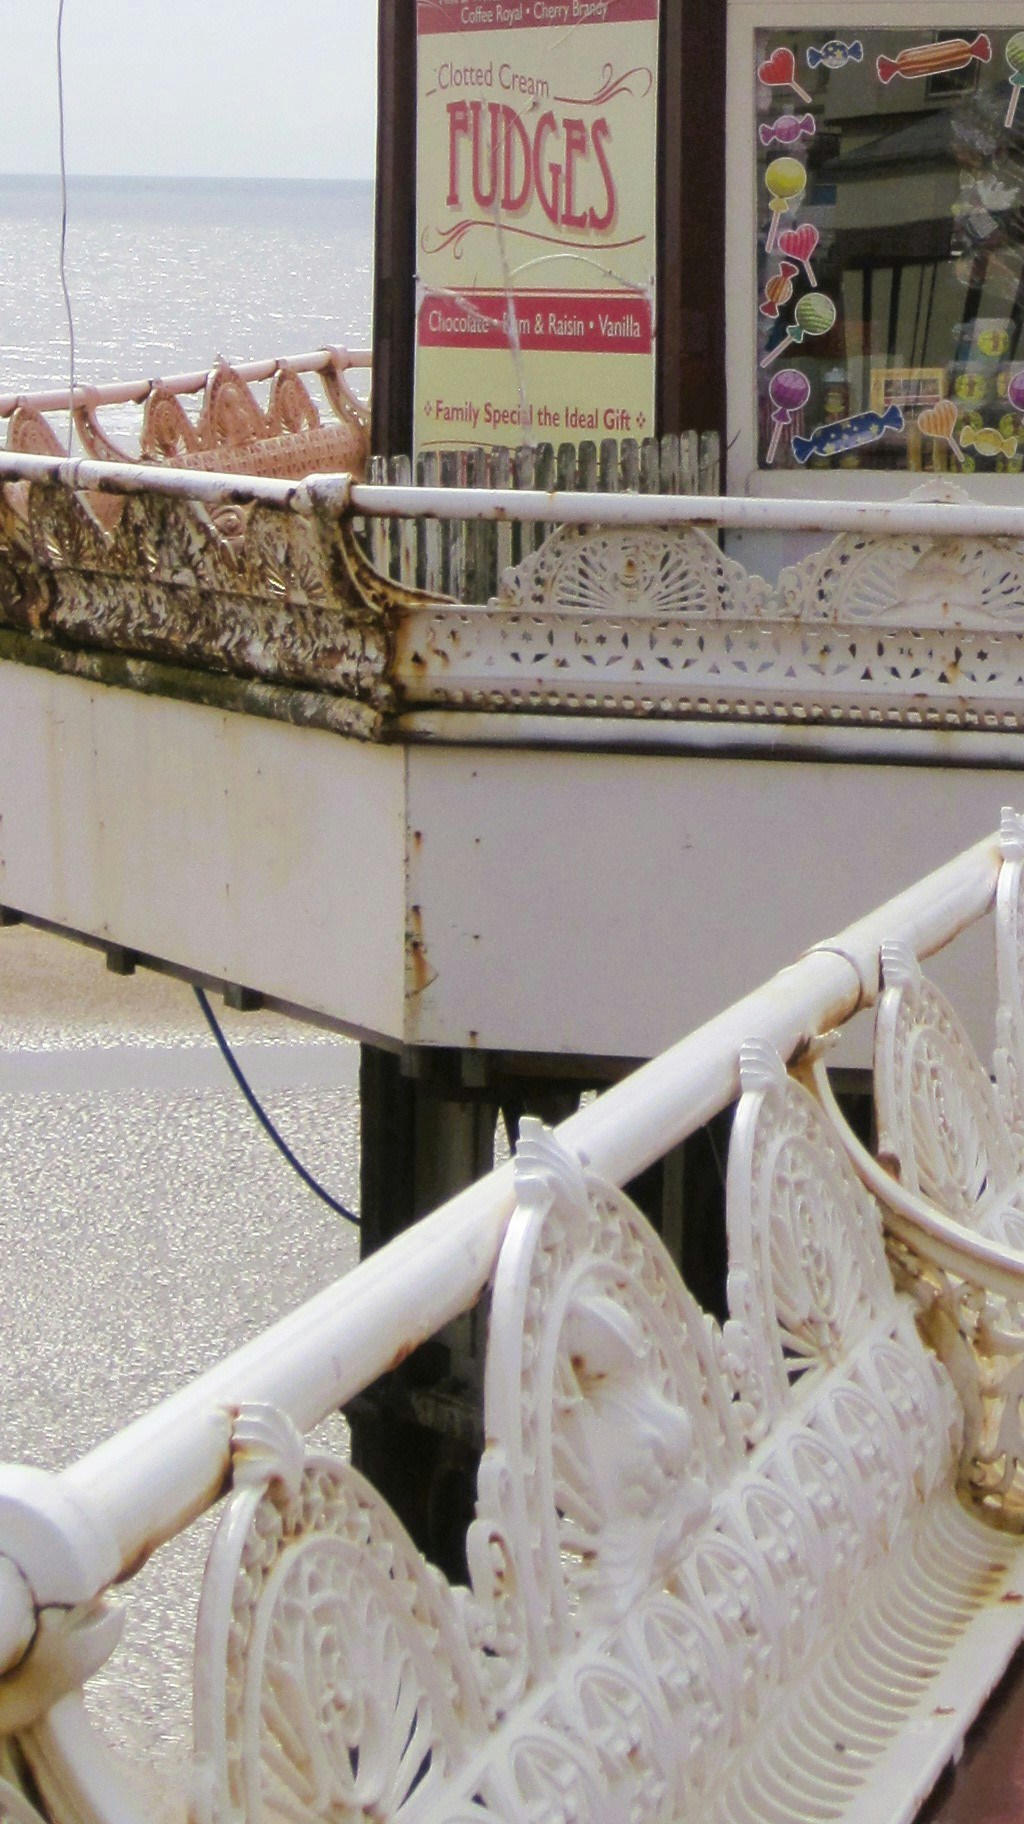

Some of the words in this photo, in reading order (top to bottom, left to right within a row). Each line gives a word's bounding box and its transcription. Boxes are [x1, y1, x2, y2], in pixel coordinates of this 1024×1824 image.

[461, 7, 493, 25] Coffee
[497, 4, 523, 25] Royal
[534, 1, 568, 22] Cherry
[573, 0, 608, 20] Brandy
[438, 62, 493, 90] Clotted
[498, 63, 550, 98] Cream
[446, 99, 618, 232] FUDGES
[429, 310, 489, 334] Chocolate
[534, 313, 544, 335] &
[549, 313, 585, 336] Raisin
[599, 314, 641, 338] Vanilla
[435, 400, 480, 428] Family
[484, 402, 533, 429] Specil
[537, 405, 560, 427] the
[565, 406, 599, 429] Ideal
[603, 408, 631, 431] Gift
